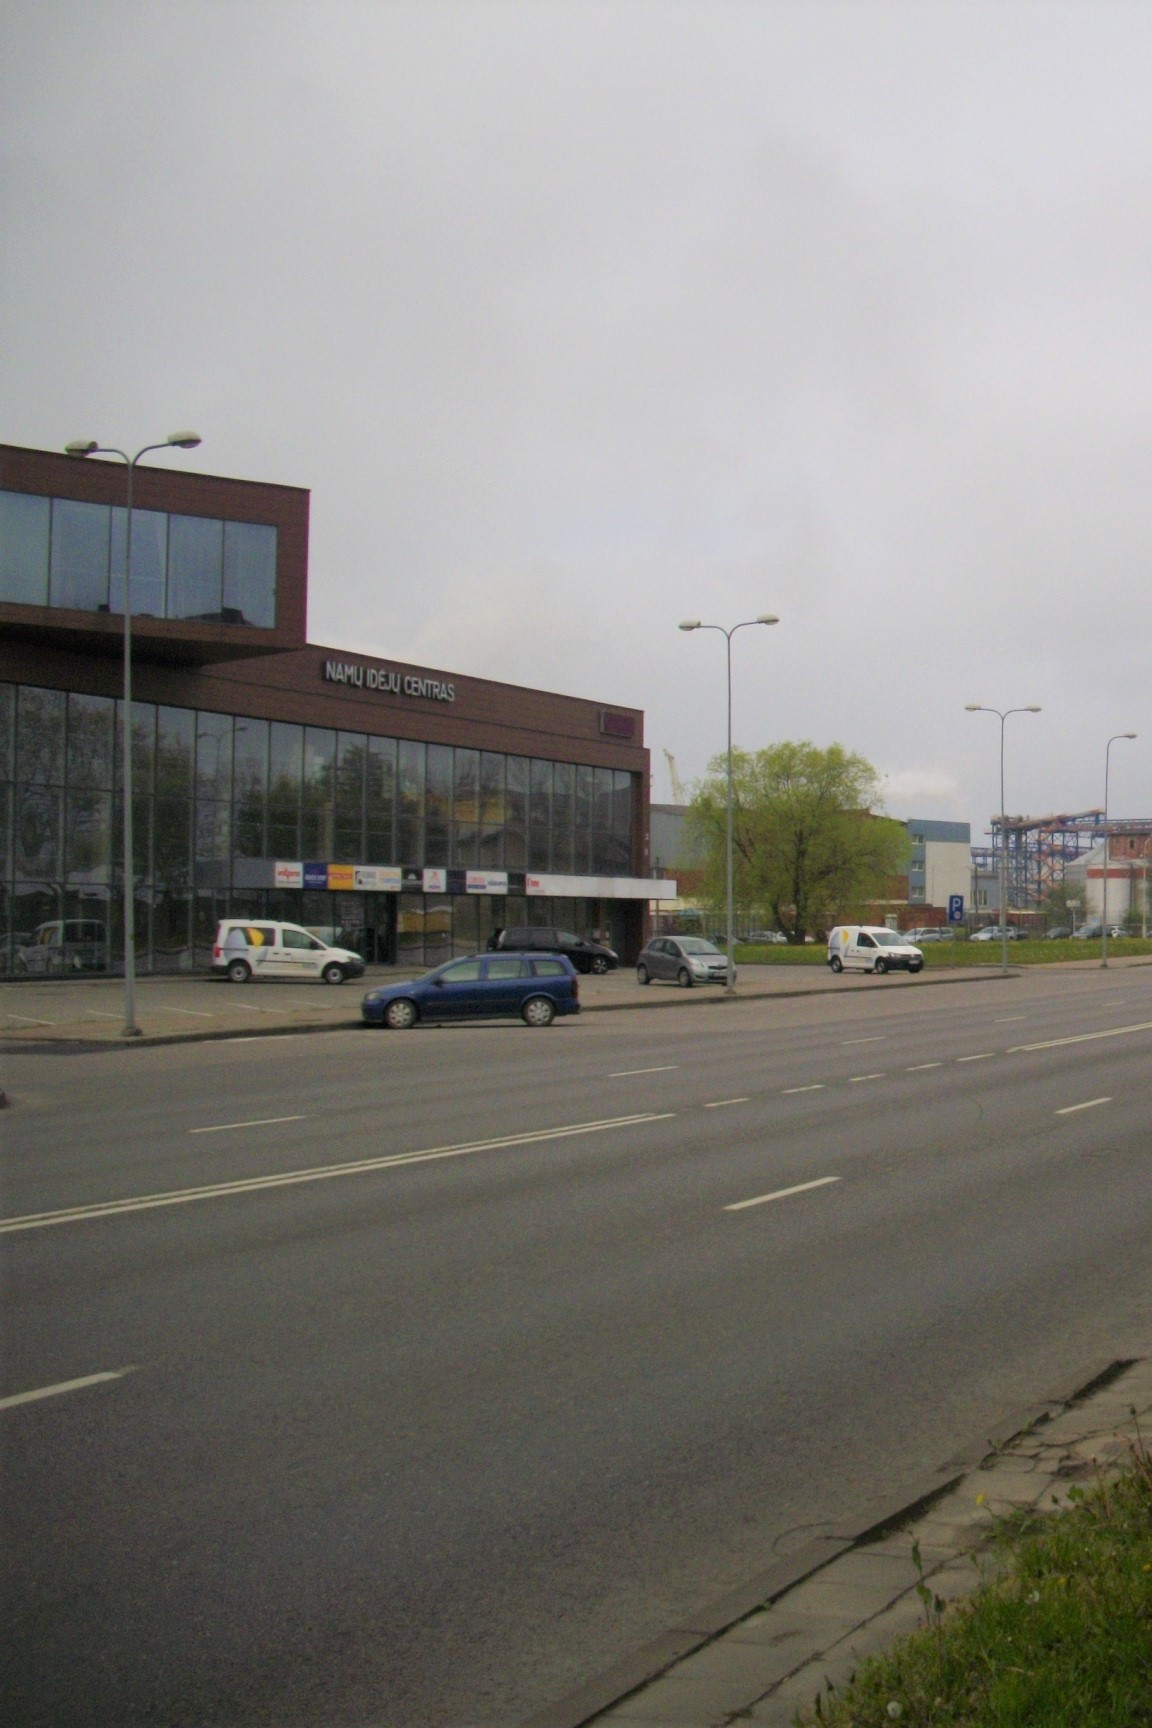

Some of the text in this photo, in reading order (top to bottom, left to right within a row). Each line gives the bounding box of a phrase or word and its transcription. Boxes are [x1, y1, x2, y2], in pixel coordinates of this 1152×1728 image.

[326, 660, 455, 702] NAMŲ IDĖJŲ CENTRAS
[952, 897, 962, 912] P
